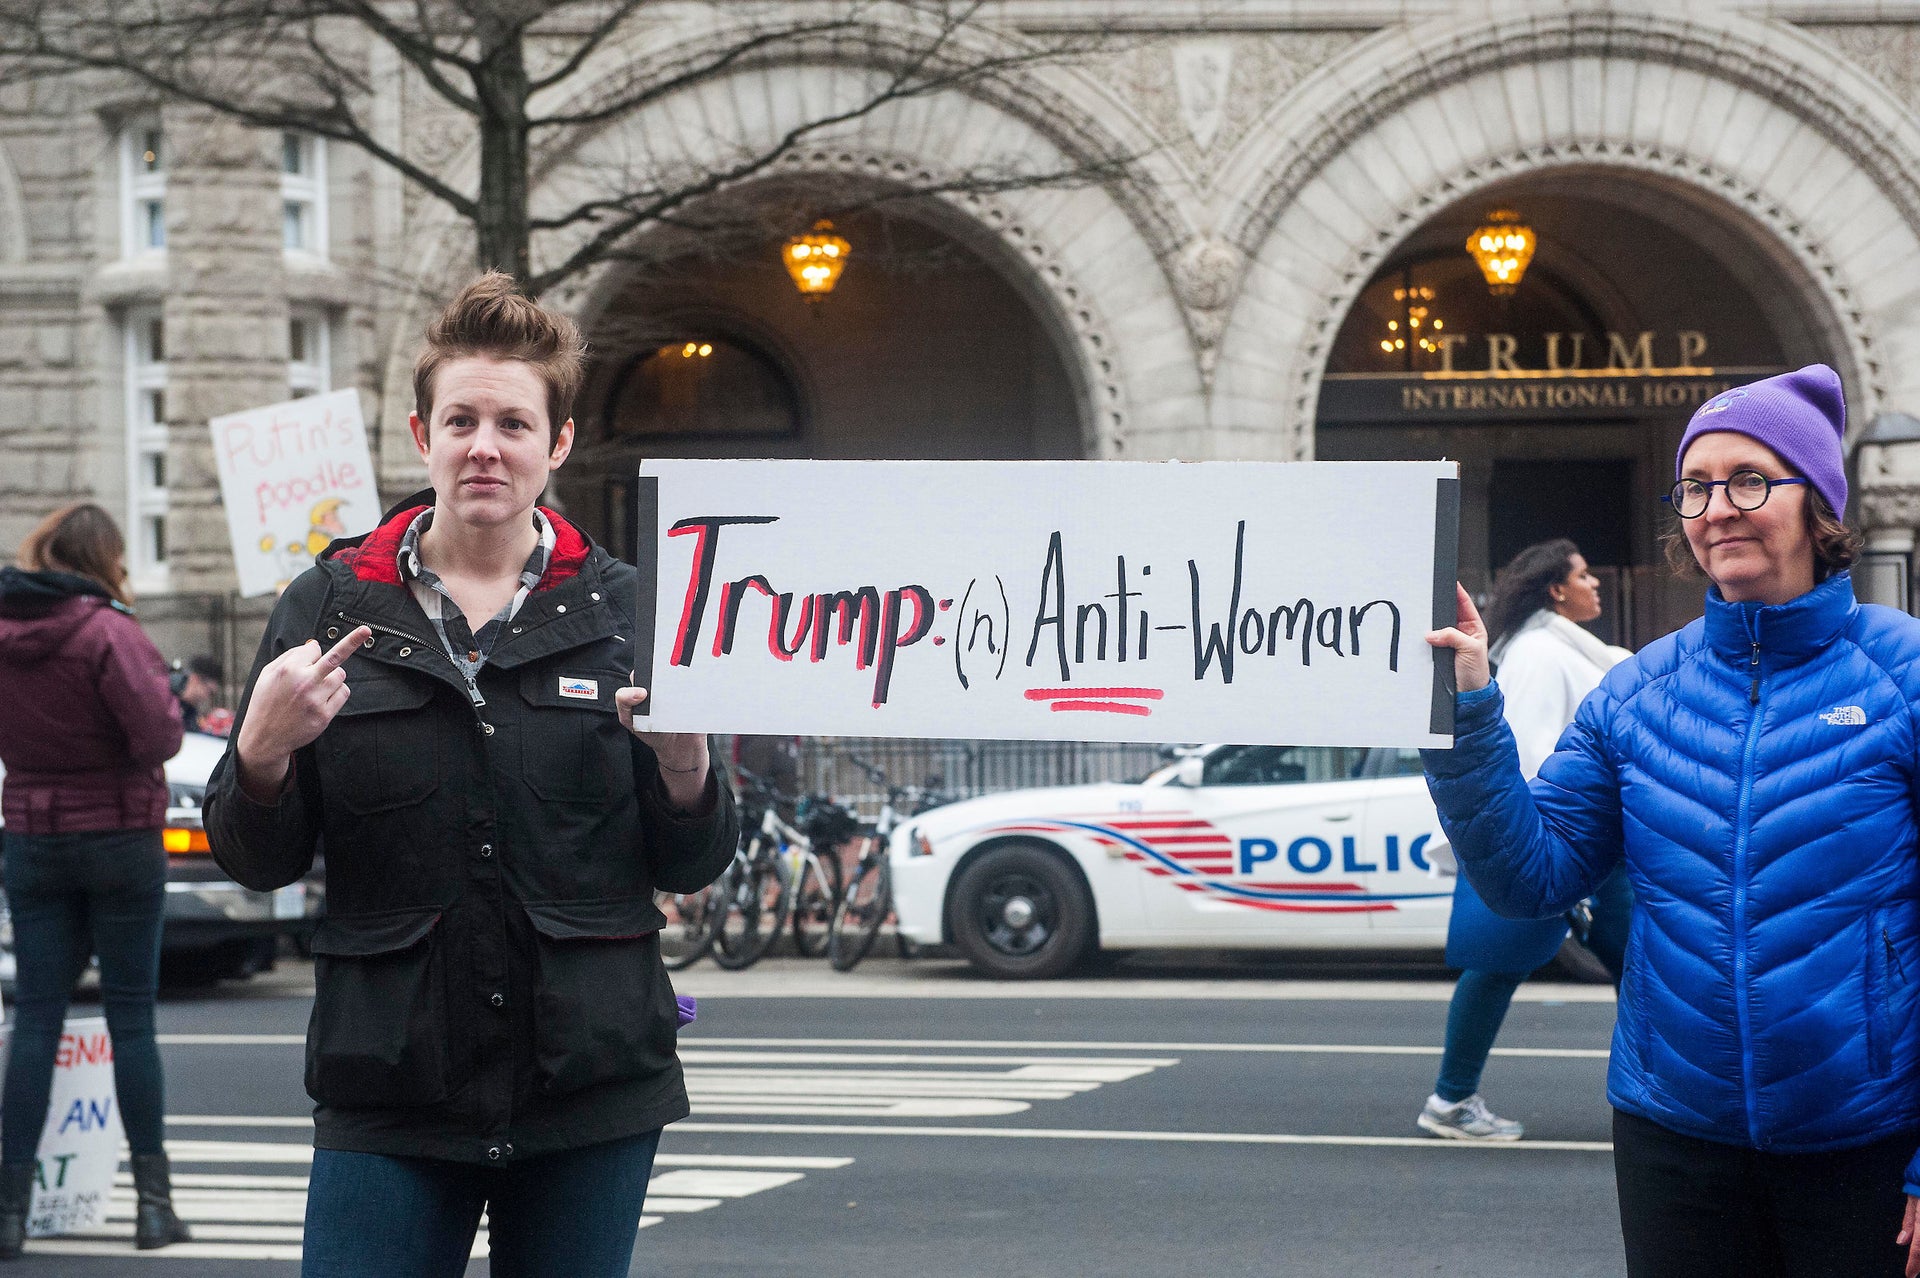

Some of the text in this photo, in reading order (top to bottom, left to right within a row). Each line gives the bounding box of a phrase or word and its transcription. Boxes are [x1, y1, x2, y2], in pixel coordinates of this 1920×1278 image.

[1431, 331, 1708, 371] TRUMP
[1402, 381, 1729, 409] INTERNATIONAL HOTE
[255, 460, 364, 526] poodle
[667, 515, 954, 710] Trump:
[1025, 520, 1401, 684] Anti-Woman
[57, 1096, 112, 1135] AN
